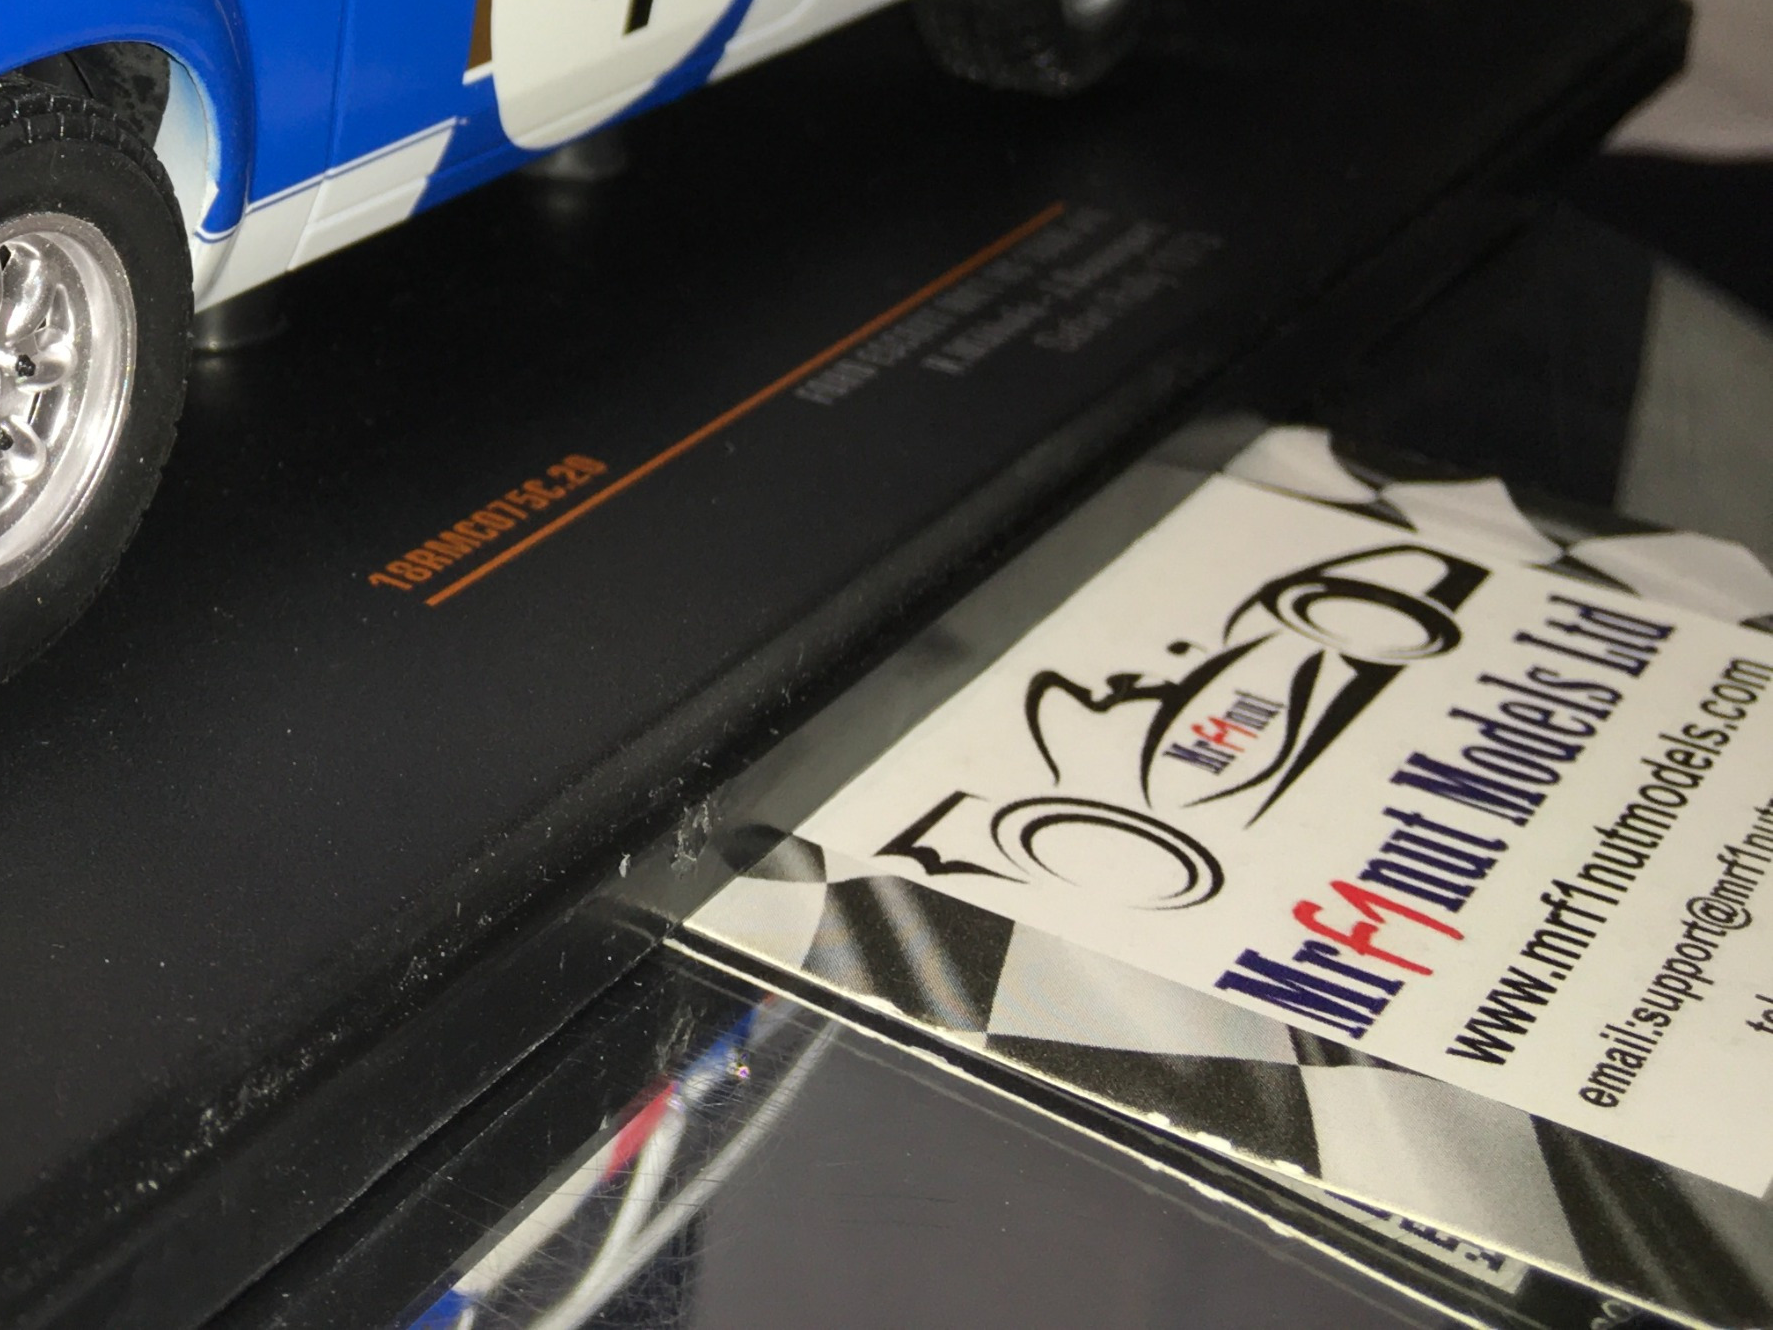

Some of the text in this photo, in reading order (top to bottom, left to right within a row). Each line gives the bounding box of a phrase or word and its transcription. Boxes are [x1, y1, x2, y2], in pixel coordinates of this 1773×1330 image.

[1389, 663, 1625, 828] Models
[1513, 594, 1678, 680] Ltd
[1445, 657, 1773, 1067] www.mrf1nutmodels.com
